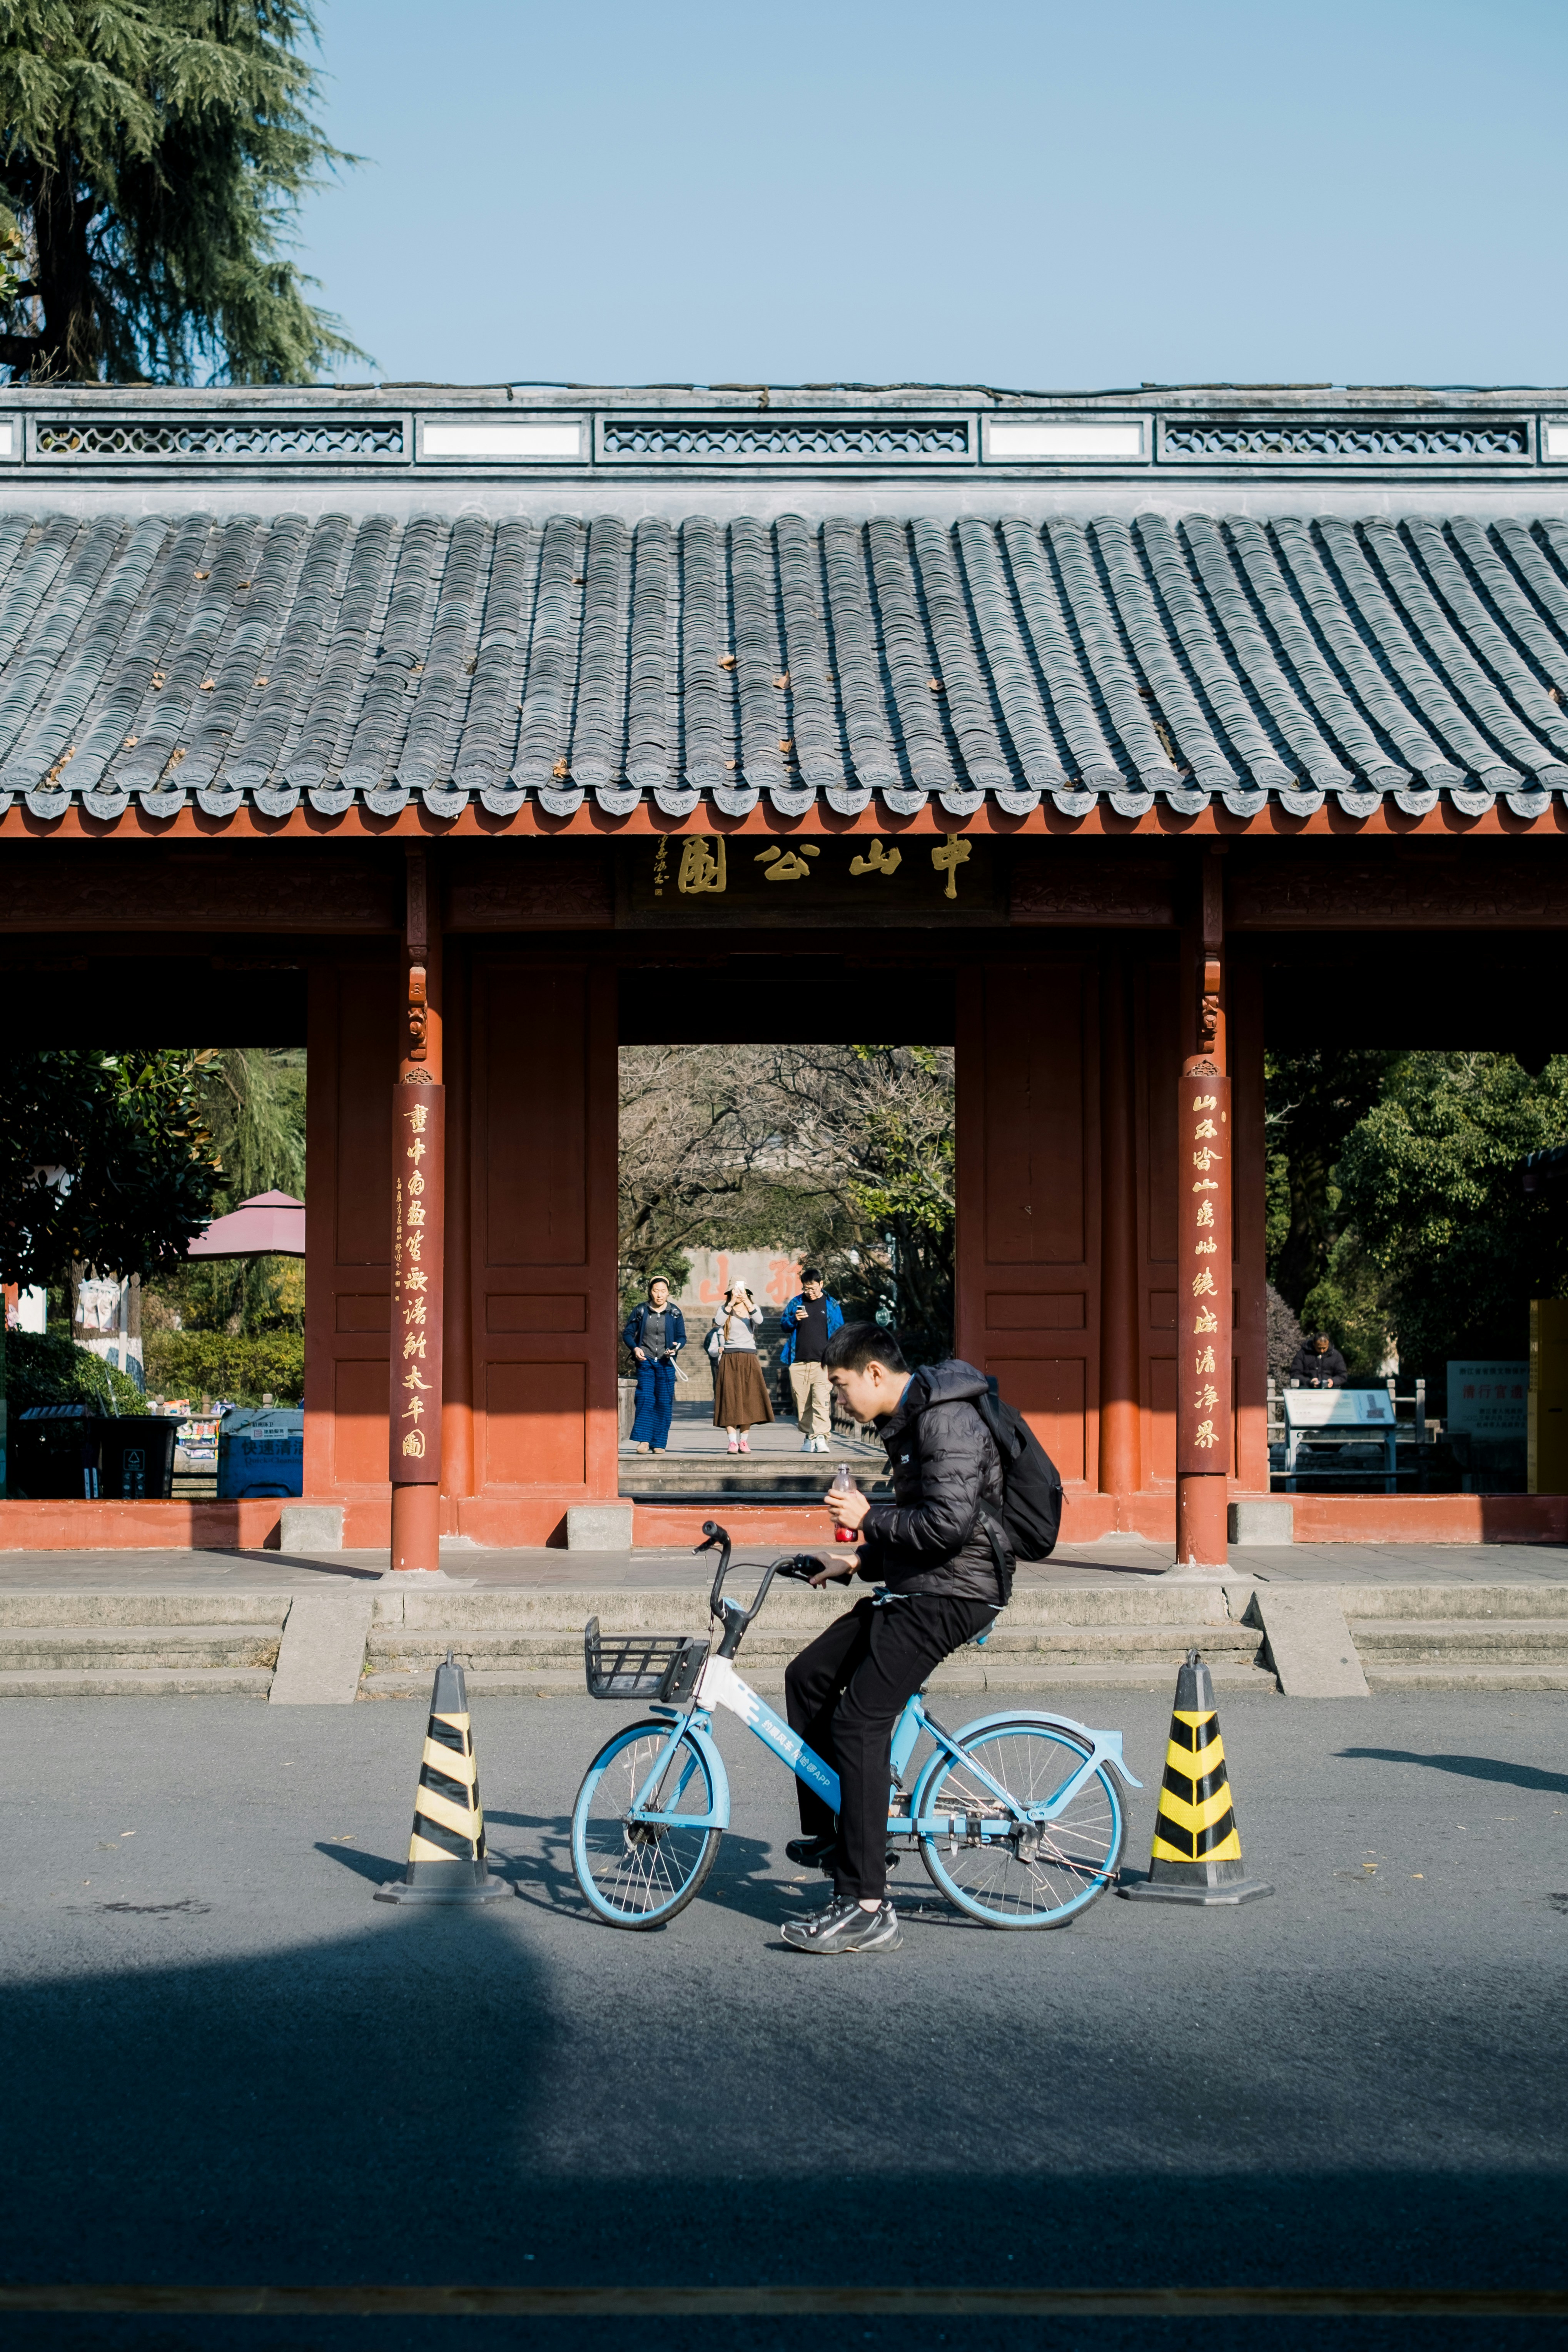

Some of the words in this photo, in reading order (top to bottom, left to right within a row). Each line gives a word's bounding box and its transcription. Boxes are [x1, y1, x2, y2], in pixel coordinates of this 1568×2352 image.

[1463, 1384, 1530, 1399] 清行宫遗
[761, 1719, 794, 1752] 约顺风车
